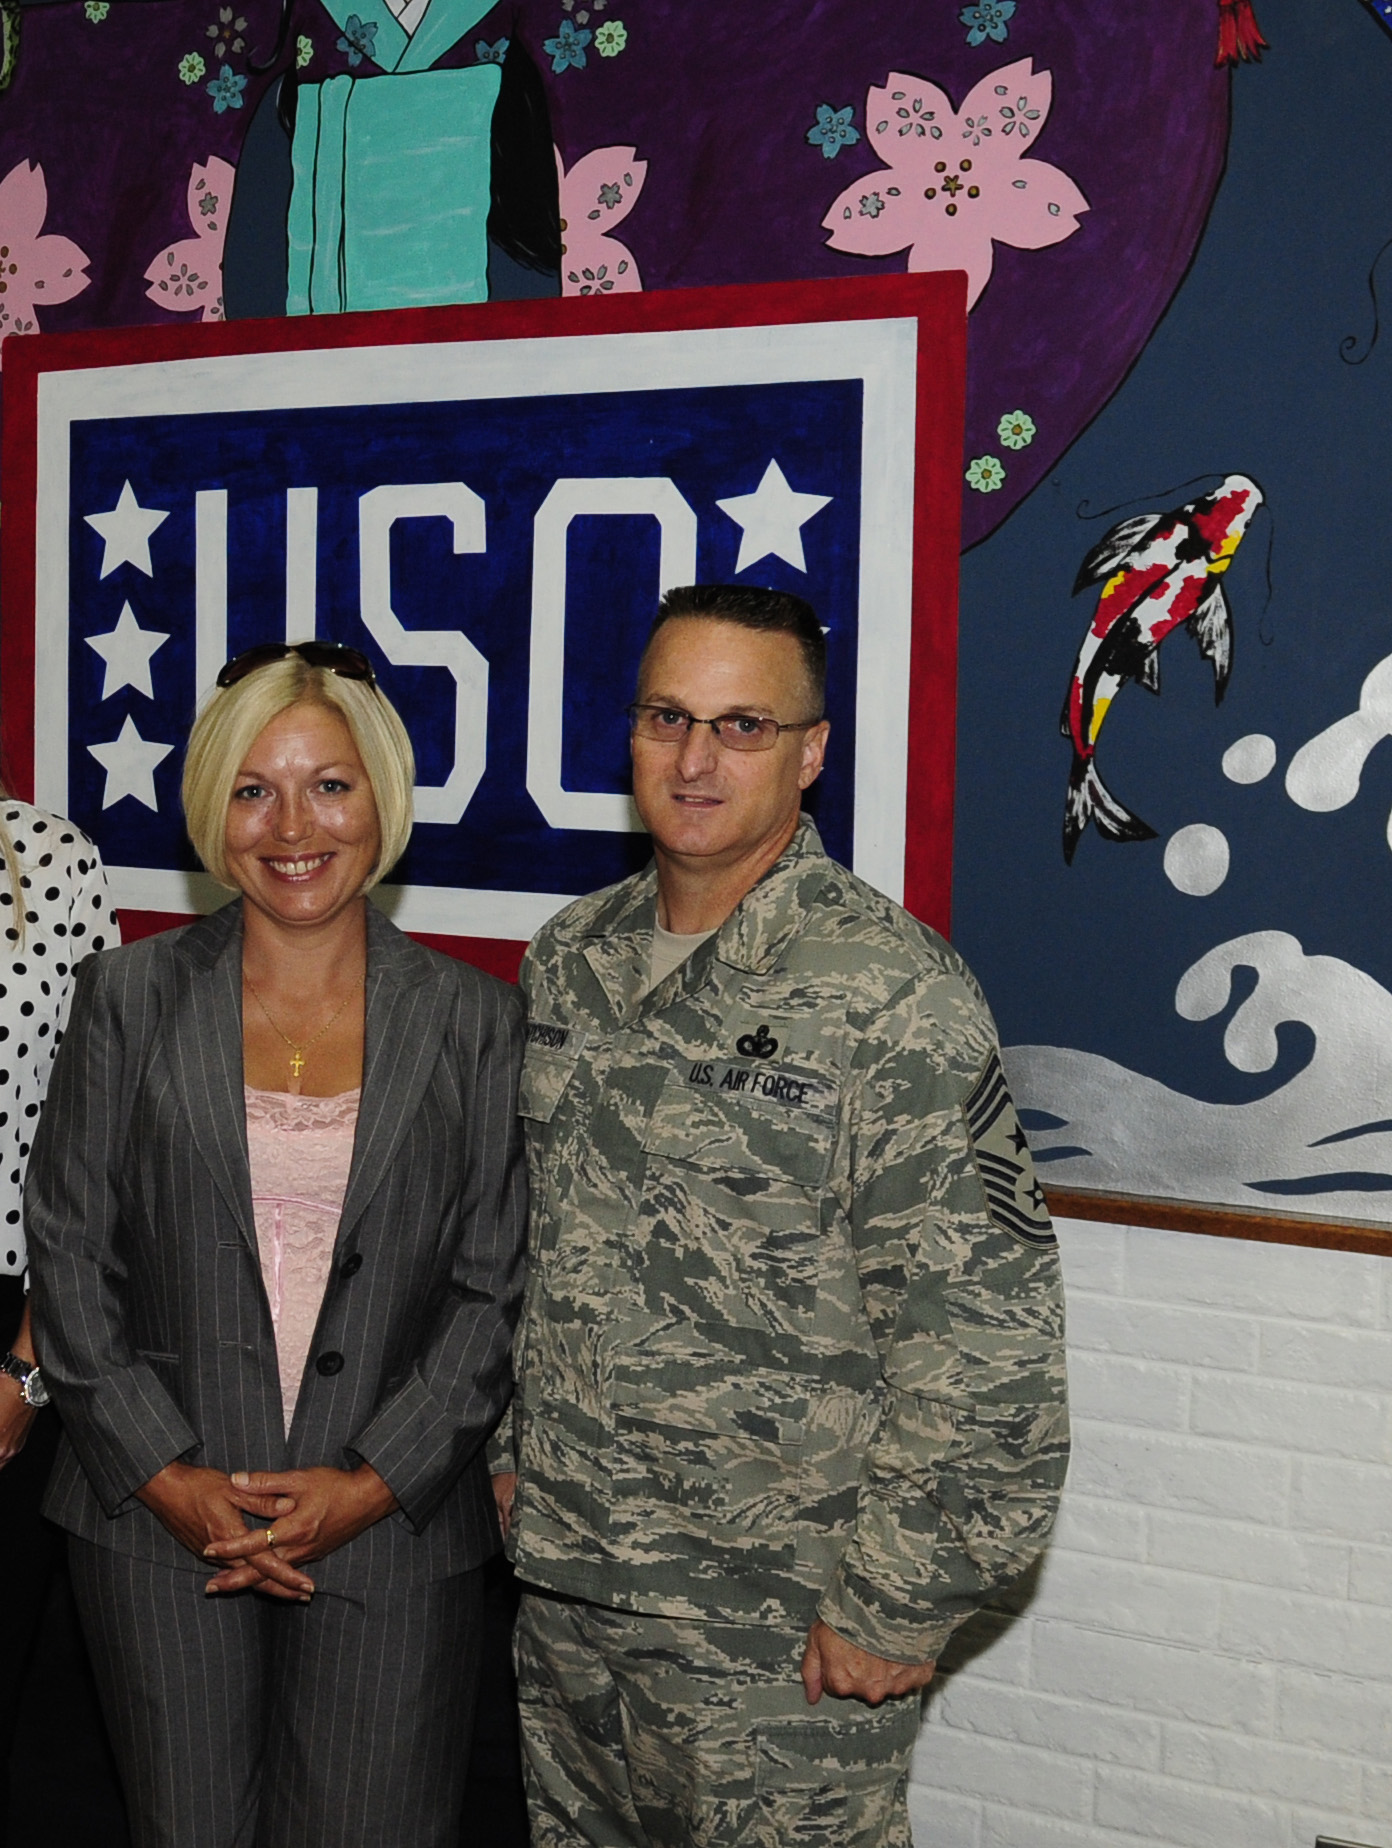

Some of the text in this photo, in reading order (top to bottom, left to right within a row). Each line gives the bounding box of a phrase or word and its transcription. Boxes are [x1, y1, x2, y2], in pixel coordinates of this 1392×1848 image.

[196, 477, 697, 833] USO
[688, 1062, 813, 1104] U.S. AIR FORCE
